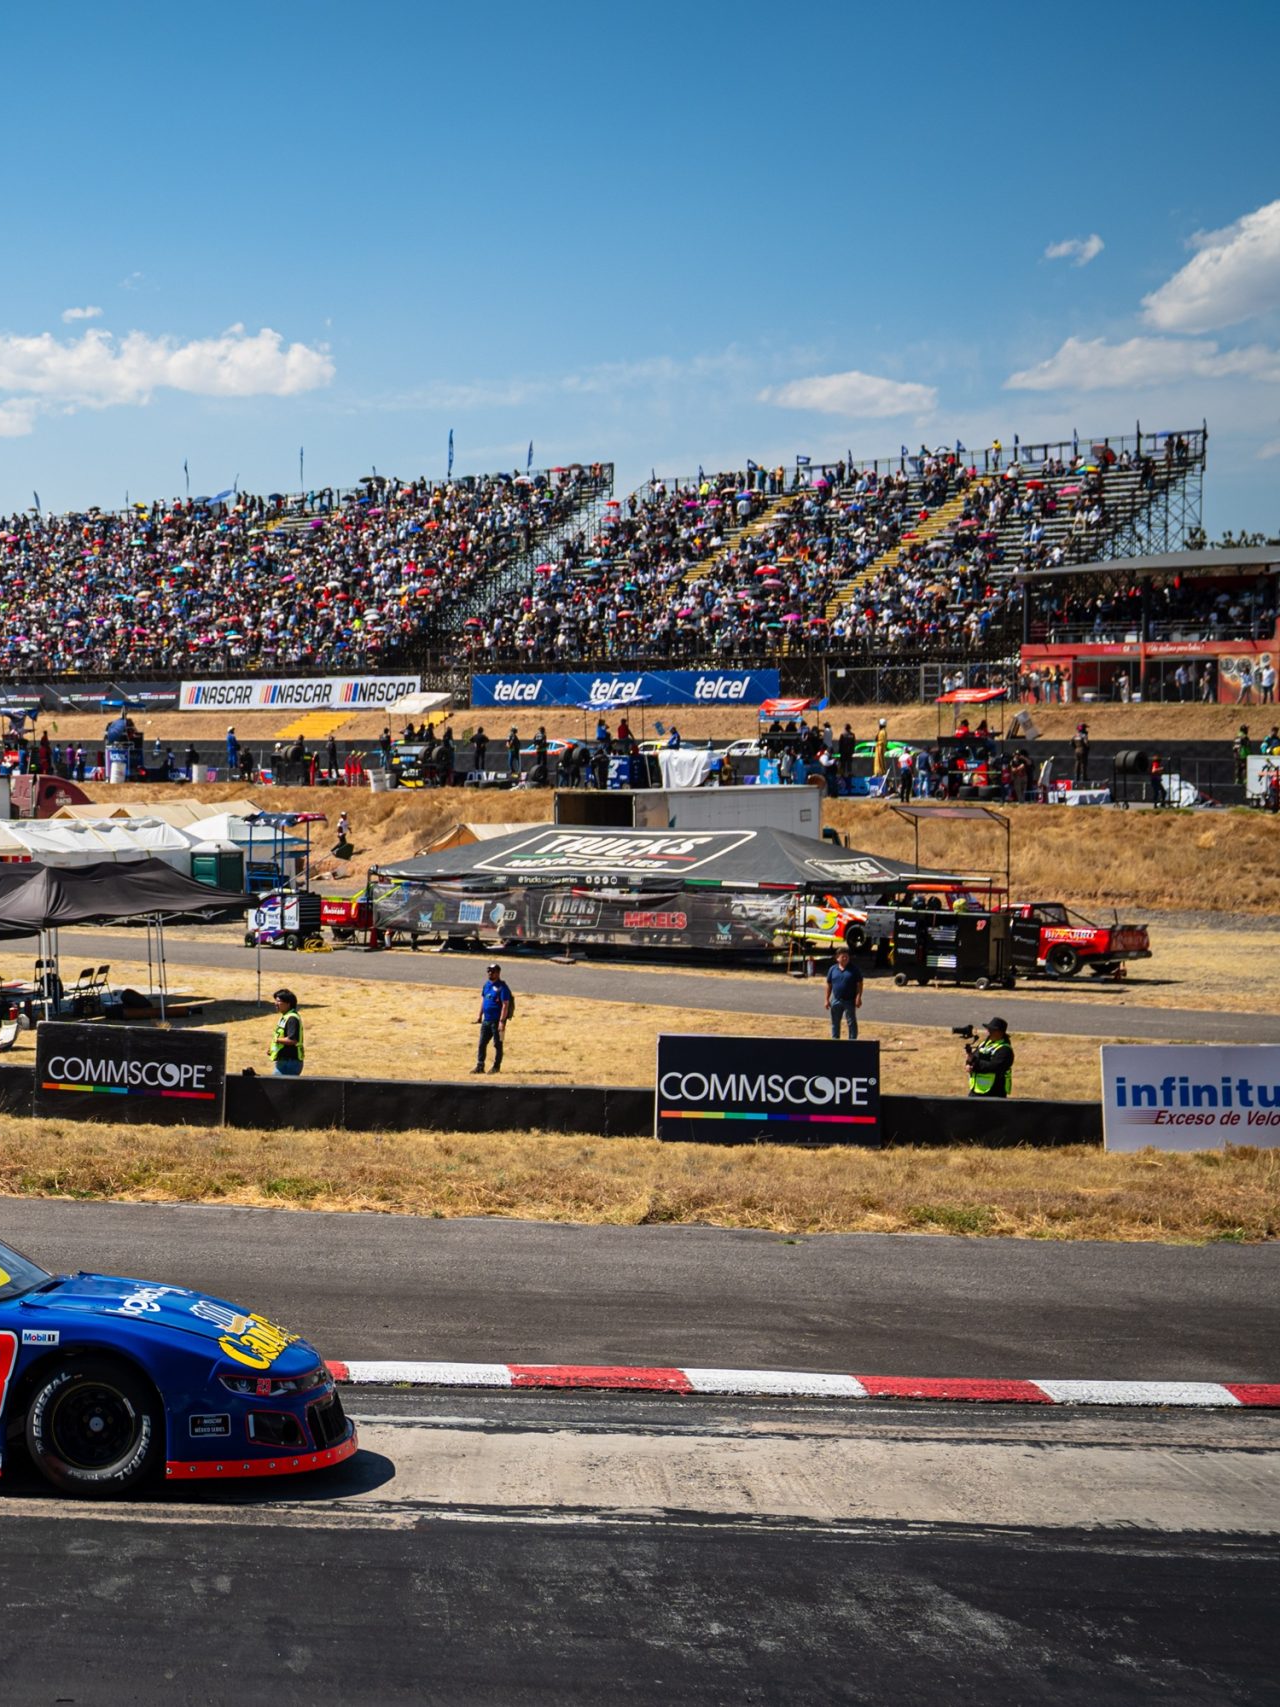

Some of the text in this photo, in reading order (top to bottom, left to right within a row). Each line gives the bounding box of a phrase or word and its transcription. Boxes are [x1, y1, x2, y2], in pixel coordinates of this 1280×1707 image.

[201, 685, 253, 704] NASCAR
[276, 683, 332, 703] NASCAR
[493, 679, 543, 700] telcel
[590, 678, 643, 700] telcel
[694, 676, 750, 699] telcel
[535, 834, 713, 856] TRUCKS
[548, 899, 596, 914] TRUCKS
[623, 911, 688, 929] MIKEL'S
[48, 1056, 206, 1089] COMMSCOPE
[660, 1072, 869, 1105] COMMSCOPE
[1155, 1109, 1216, 1126] Exceso
[1219, 1110, 1242, 1126] de
[24, 1333, 56, 1343] Mobil 1
[33, 1372, 71, 1438] GENERAL
[114, 1414, 151, 1480] GENERAL
